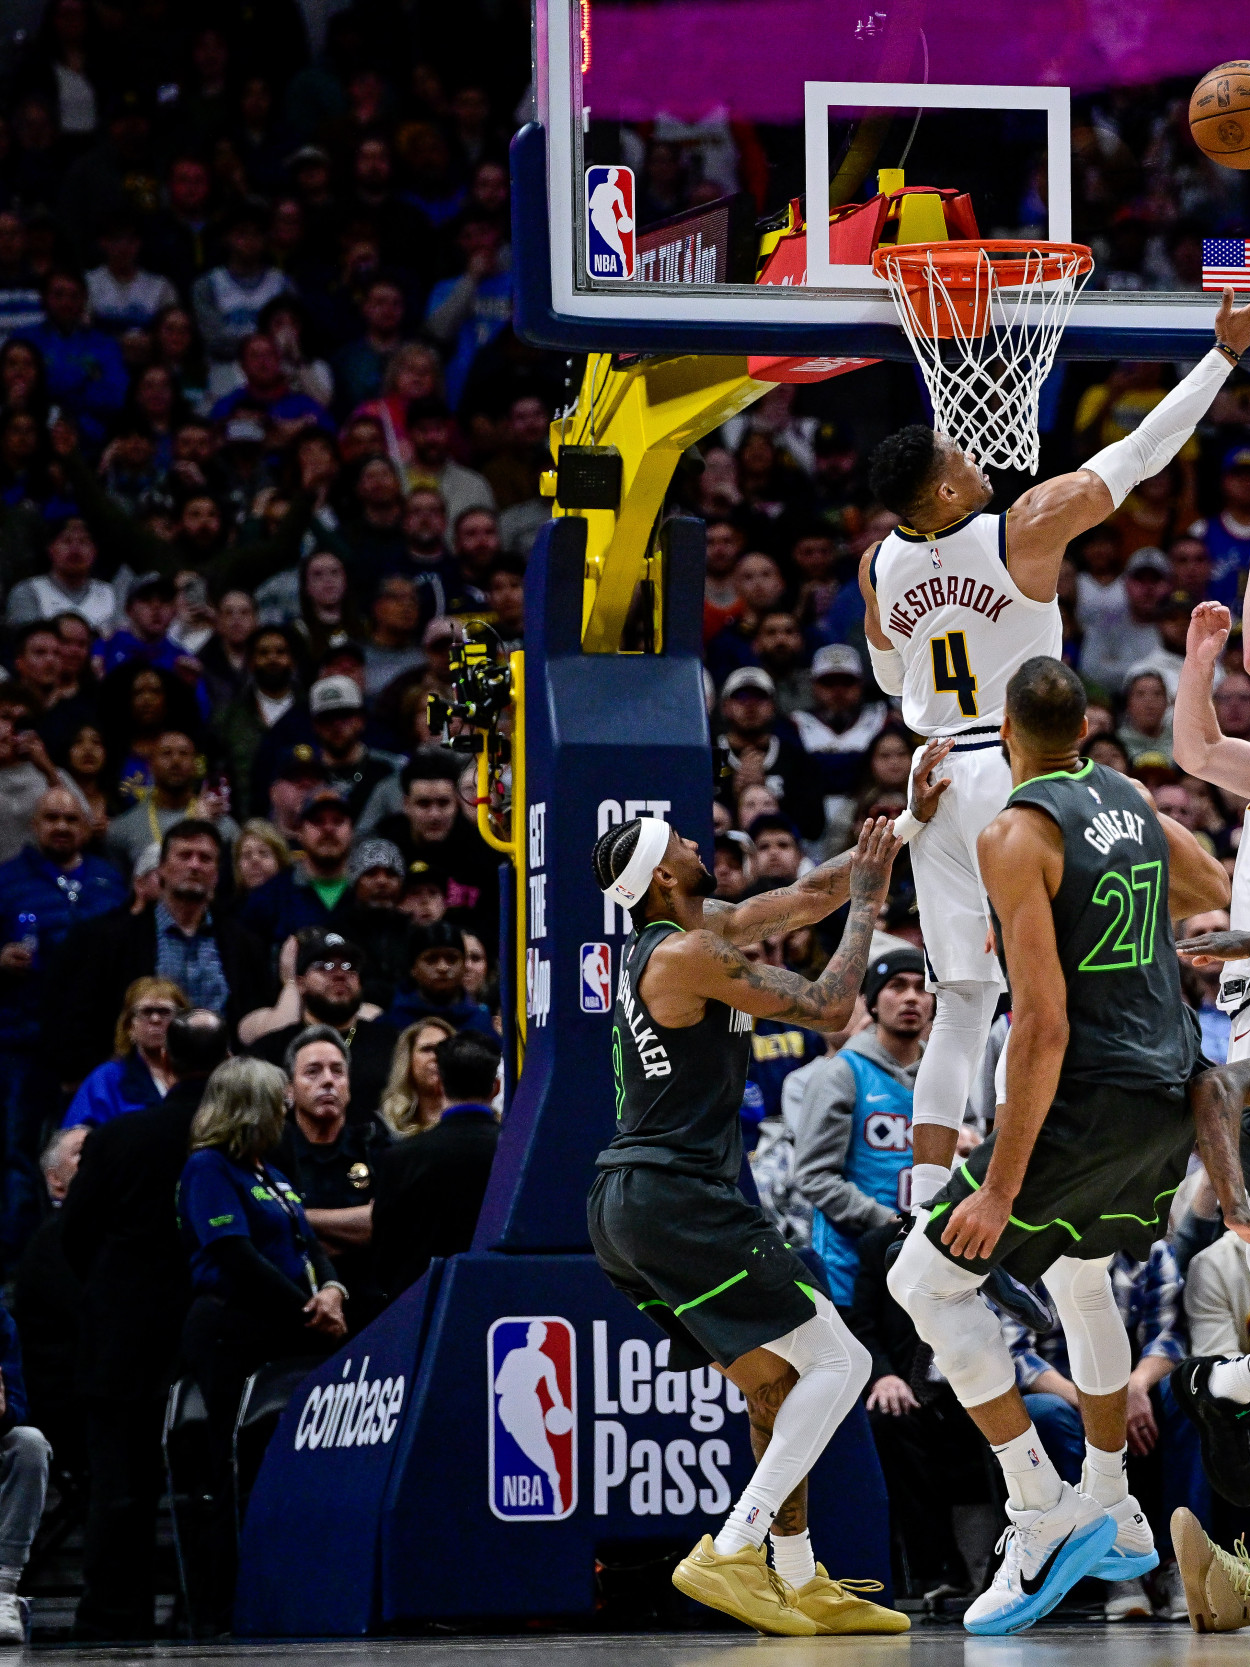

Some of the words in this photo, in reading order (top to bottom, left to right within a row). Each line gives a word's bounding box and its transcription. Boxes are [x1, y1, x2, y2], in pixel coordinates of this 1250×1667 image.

[594, 254, 618, 273] NBA
[889, 576, 1014, 640] WESTBROOK
[930, 630, 979, 718] 4
[1084, 810, 1146, 855] GOBERT
[1078, 860, 1163, 971] 27
[295, 1355, 406, 1451] coinbase
[502, 1475, 544, 1507] NBA
[594, 1420, 732, 1516] Pass
